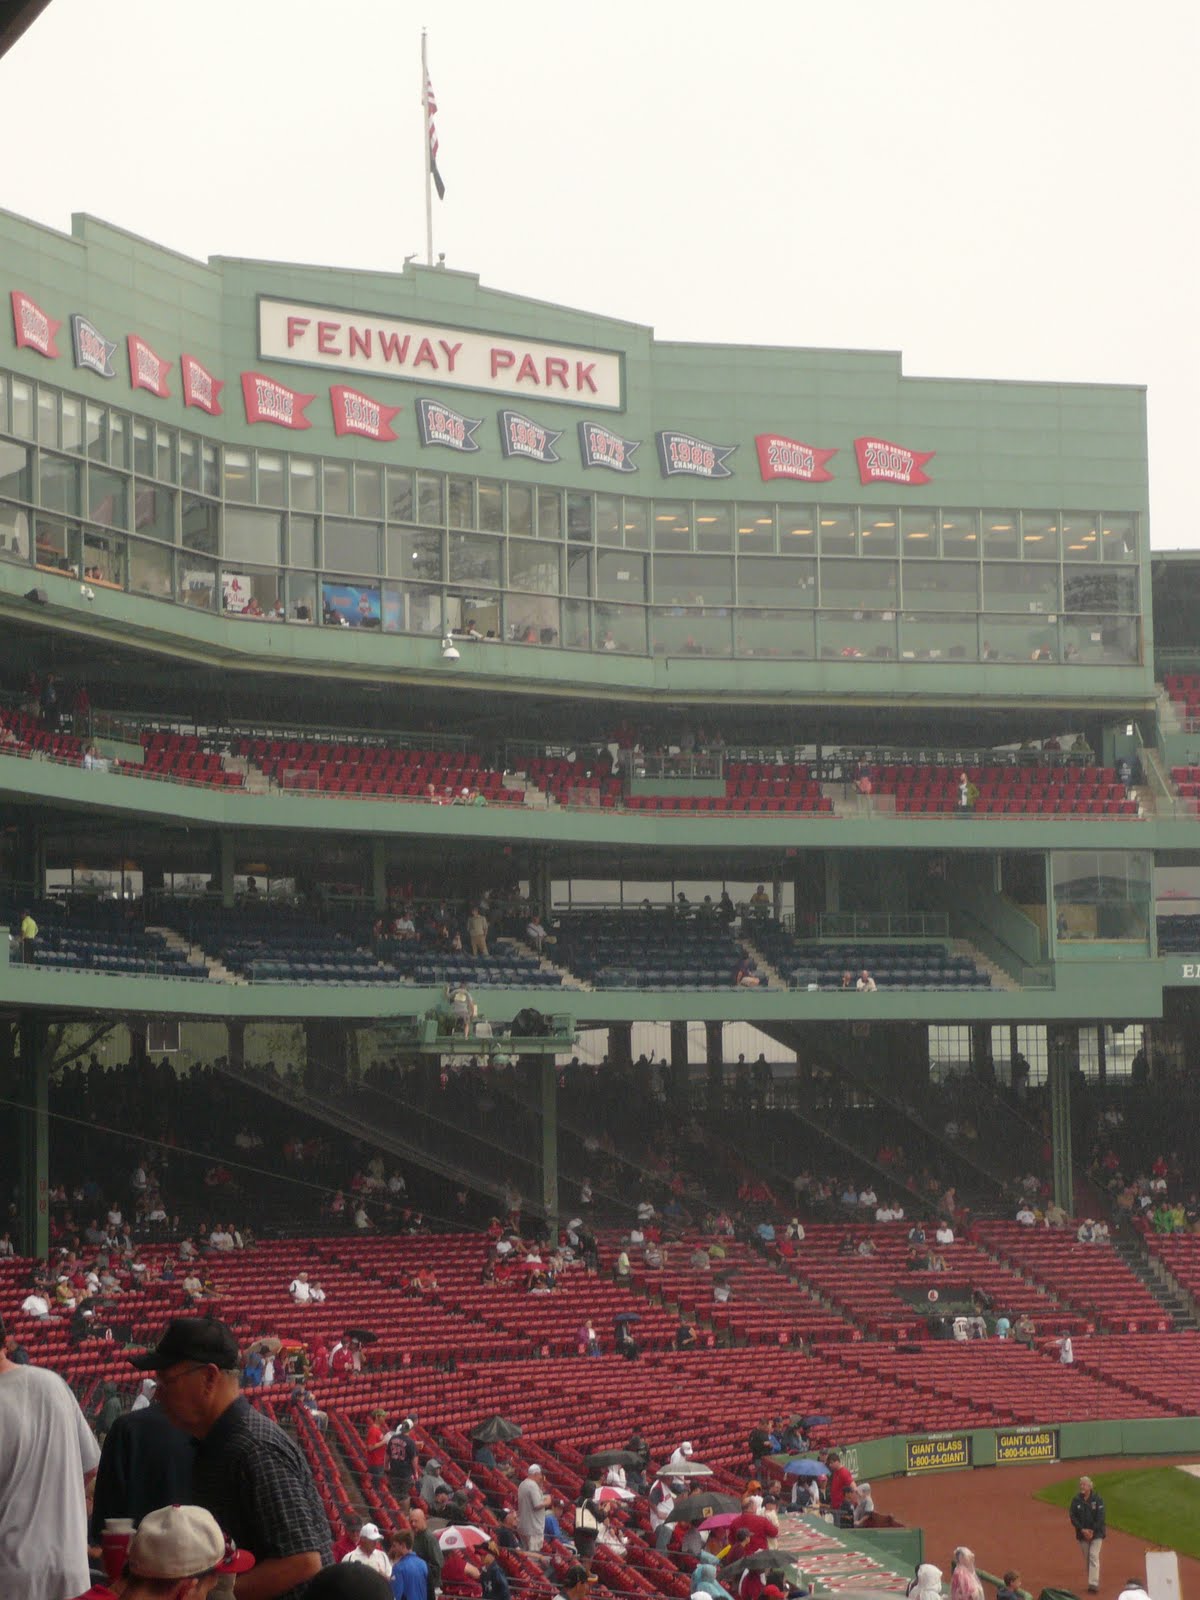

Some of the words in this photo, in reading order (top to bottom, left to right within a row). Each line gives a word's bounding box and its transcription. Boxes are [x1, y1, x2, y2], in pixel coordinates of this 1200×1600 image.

[287, 316, 463, 372] FENWAY
[490, 347, 599, 393] PARK
[255, 379, 275, 391] WORLD
[256, 385, 294, 417] 1916
[343, 391, 362, 402] WORLD
[258, 406, 293, 424] CHAMPIONS
[345, 399, 380, 428] 1918
[346, 418, 379, 435] CHAMPIONS
[428, 410, 465, 441] 1946
[431, 430, 463, 448] CHAMPIONS
[510, 422, 546, 452] 1967
[770, 440, 792, 449] WORLD
[513, 442, 544, 459] CHAMPIONS
[590, 432, 625, 463] 1975
[670, 442, 715, 469] 1986
[866, 442, 889, 452] WORLD
[593, 451, 623, 469] CHAMPIONS
[768, 445, 815, 473] 2004
[865, 448, 914, 475] 2007
[673, 460, 712, 476] CHAMPIONS
[773, 464, 811, 478] CHAMPIONS
[871, 468, 910, 482] CHAMPIONS
[1182, 964, 1200, 978] E
[911, 1443, 935, 1455] GIANT
[936, 1440, 963, 1453] GLASS
[1000, 1435, 1024, 1447] GIANT
[1025, 1433, 1050, 1445] GLASS
[910, 1451, 965, 1467] 1-800-54-GIANT
[998, 1445, 1053, 1458] 1-800-54-GIANT
